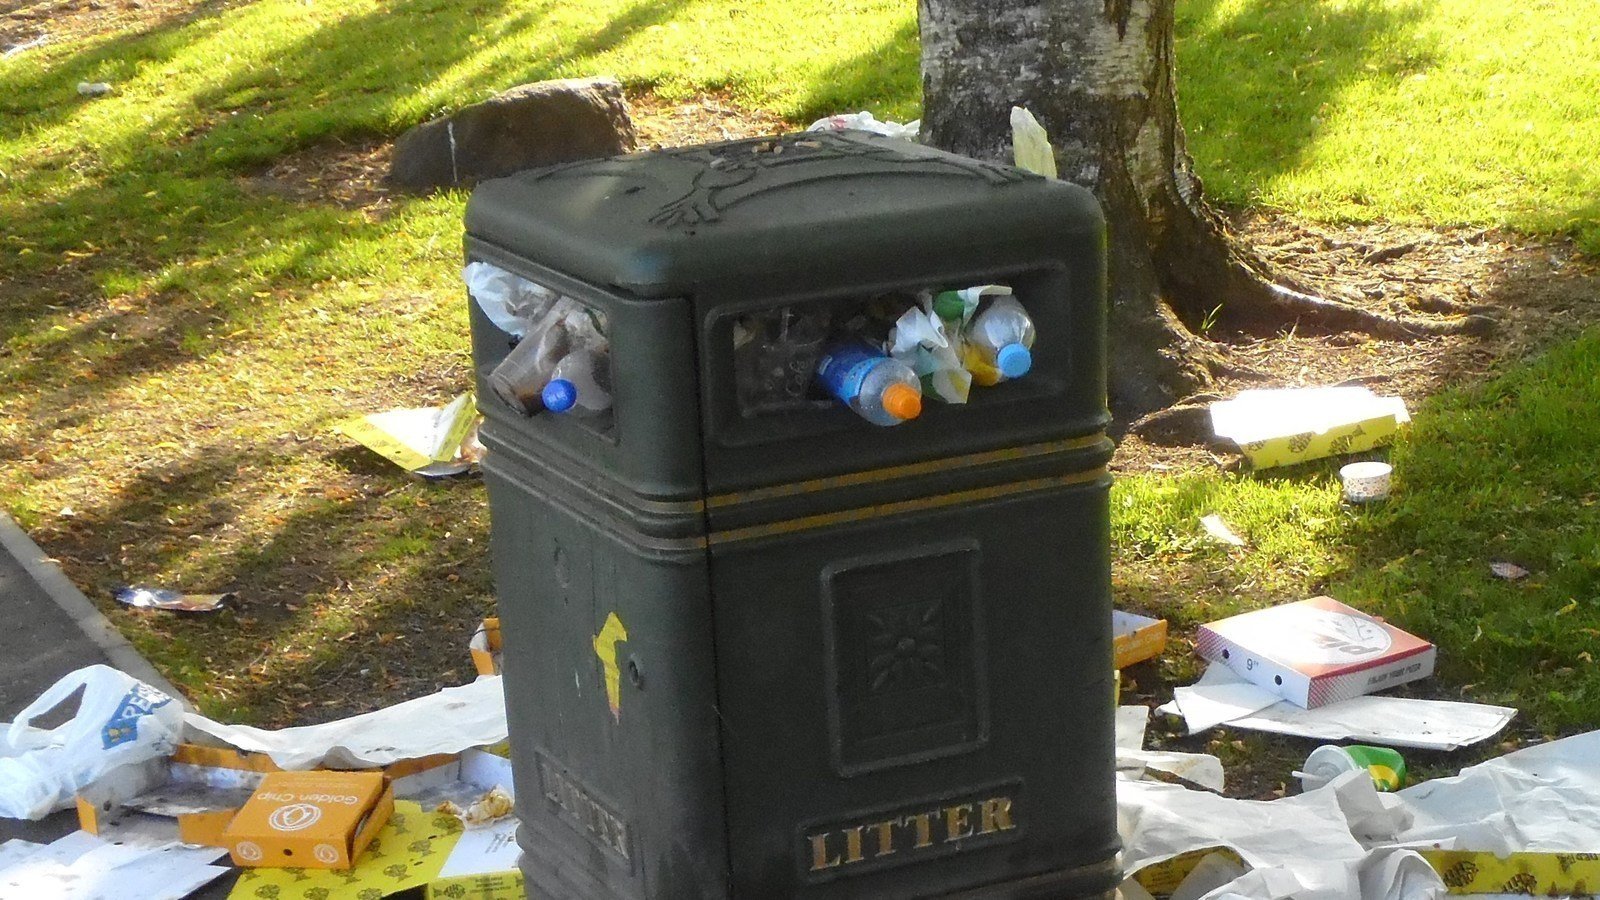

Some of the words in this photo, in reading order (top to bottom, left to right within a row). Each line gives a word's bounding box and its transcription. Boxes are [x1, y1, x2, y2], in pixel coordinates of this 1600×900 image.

[257, 791, 296, 803] Chip
[299, 793, 359, 806] Golden
[806, 796, 1017, 872] LITTER
